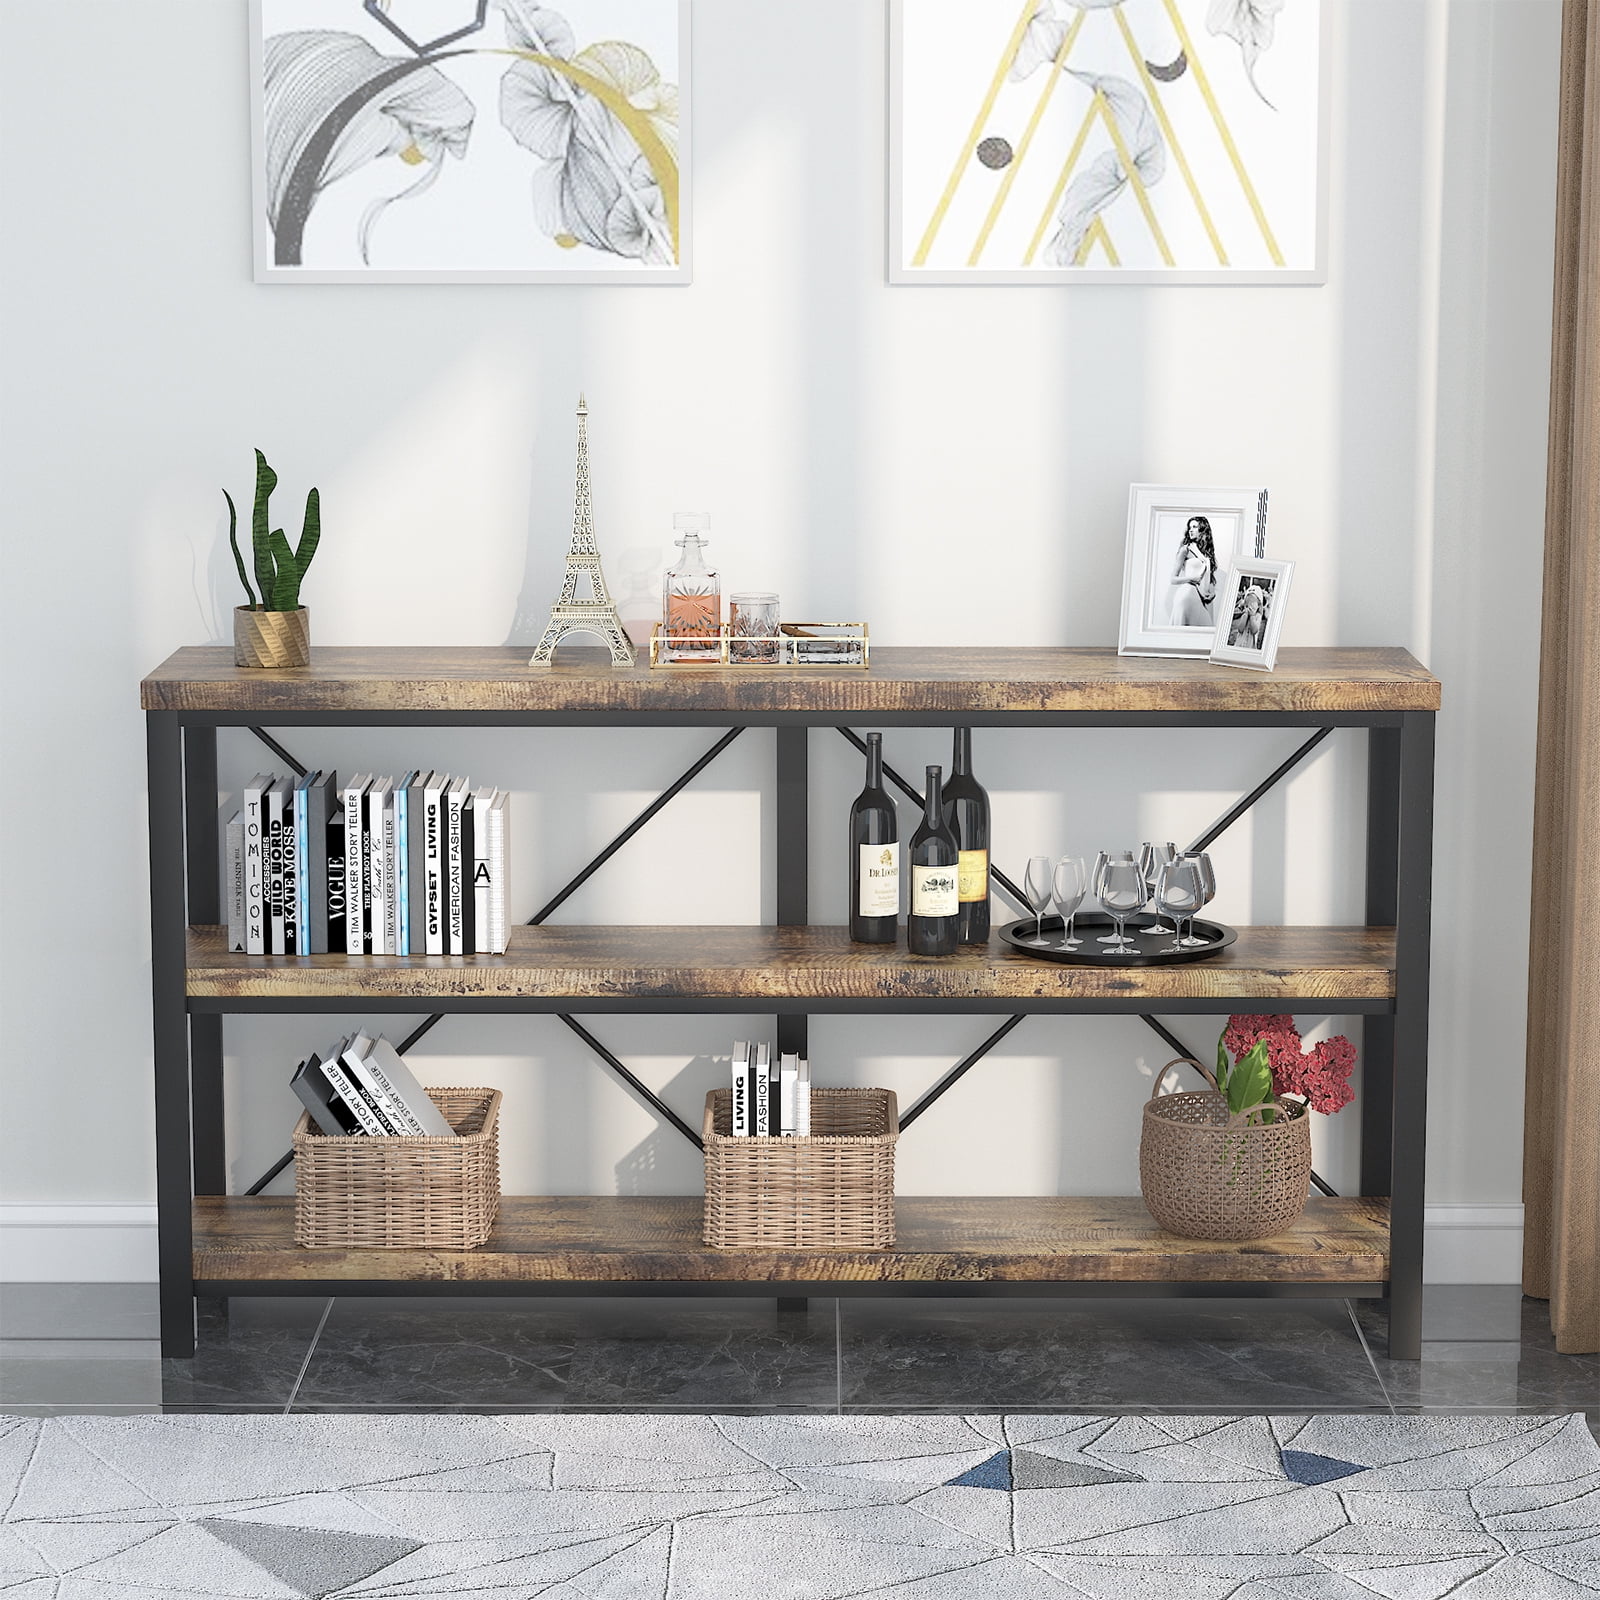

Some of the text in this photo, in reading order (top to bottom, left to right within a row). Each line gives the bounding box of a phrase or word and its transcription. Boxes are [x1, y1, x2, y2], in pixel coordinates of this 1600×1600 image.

[262, 836, 271, 903] ACCESSORIES
[271, 820, 283, 917] WILD WORLD
[283, 825, 296, 924] KATE MOSS
[328, 857, 346, 921] VOGUE
[349, 795, 359, 934] TIM WALKER STORY TELLER
[363, 854, 371, 892] PLAYBOY
[385, 819, 395, 937] TIM WALKER STORY TELLER
[427, 804, 438, 936] GYPSET LIVING
[450, 802, 461, 938] AMERICAN FASHION
[474, 862, 491, 883] A
[326, 1064, 349, 1097] TELLER
[358, 1087, 372, 1107] BOOK
[370, 1065, 392, 1093] TELLER
[390, 1092, 412, 1117] STORY
[736, 1077, 744, 1130] LIVING
[759, 1075, 767, 1132] FASHION
[349, 1096, 375, 1127] STORY
